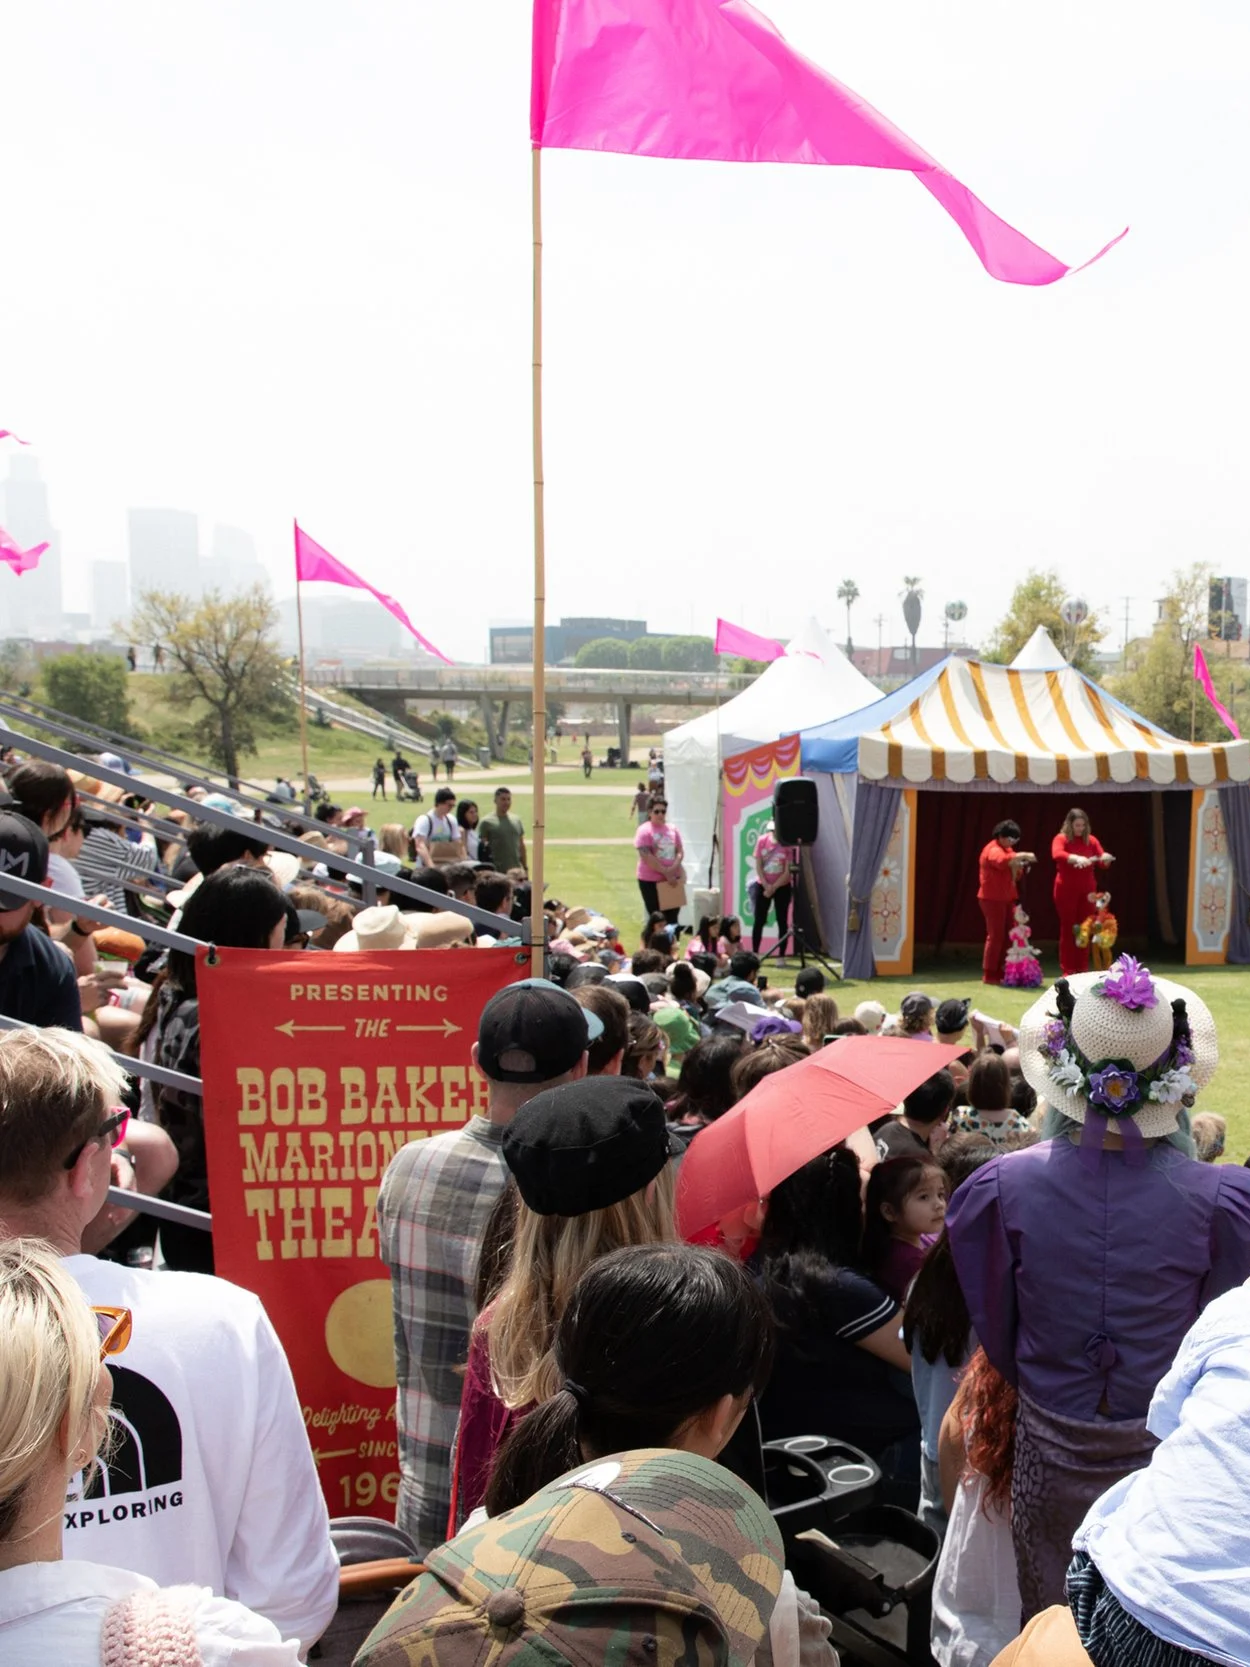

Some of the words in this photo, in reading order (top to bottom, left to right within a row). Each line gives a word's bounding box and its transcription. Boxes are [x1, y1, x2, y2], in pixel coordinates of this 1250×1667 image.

[290, 984, 448, 1002] PRESENTING
[354, 1018, 391, 1038] THE
[236, 1067, 328, 1126] BOB
[303, 1403, 381, 1436] Delighting
